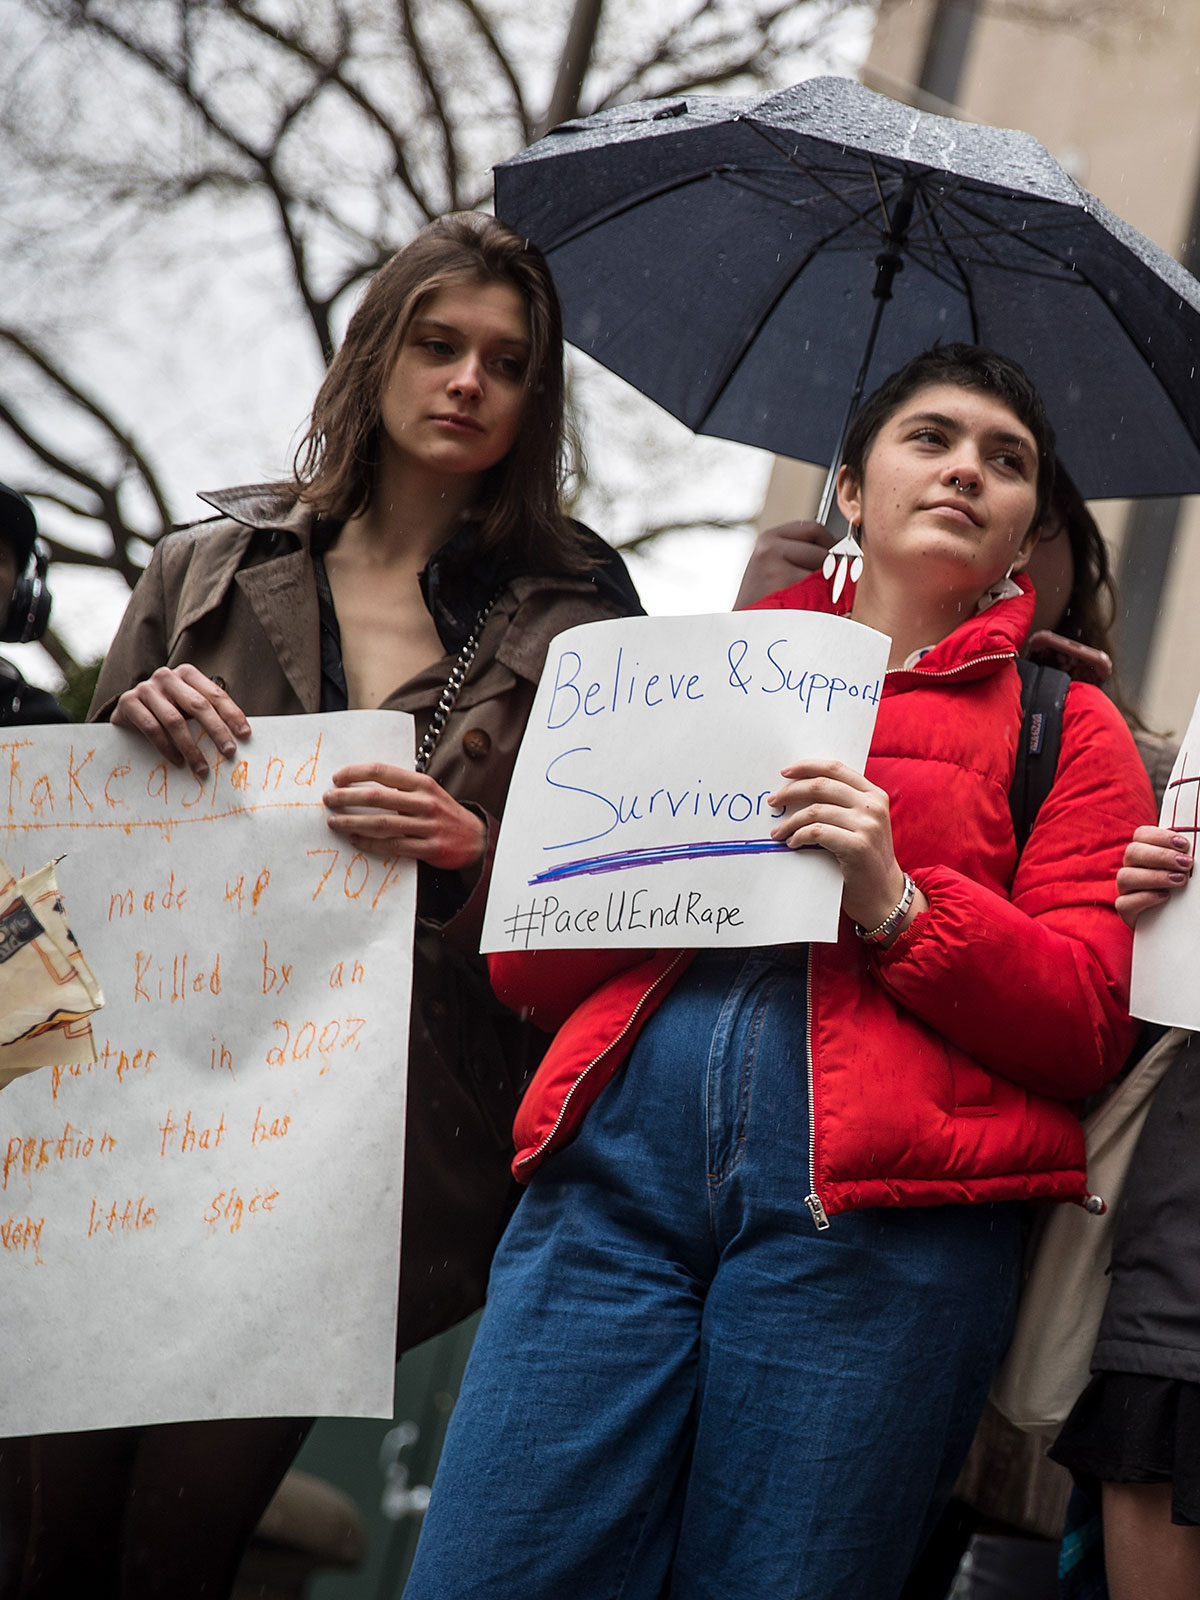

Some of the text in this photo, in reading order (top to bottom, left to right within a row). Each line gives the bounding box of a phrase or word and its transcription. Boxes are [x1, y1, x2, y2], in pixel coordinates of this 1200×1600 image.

[547, 639, 880, 730] Believe & Support
[108, 869, 188, 922] made
[305, 847, 400, 910] 70%
[503, 888, 745, 949] #PaceUEndRape
[261, 939, 294, 996] by
[328, 959, 365, 989] an
[210, 1036, 235, 1072] in
[159, 1109, 227, 1158] that
[251, 1105, 292, 1147] has
